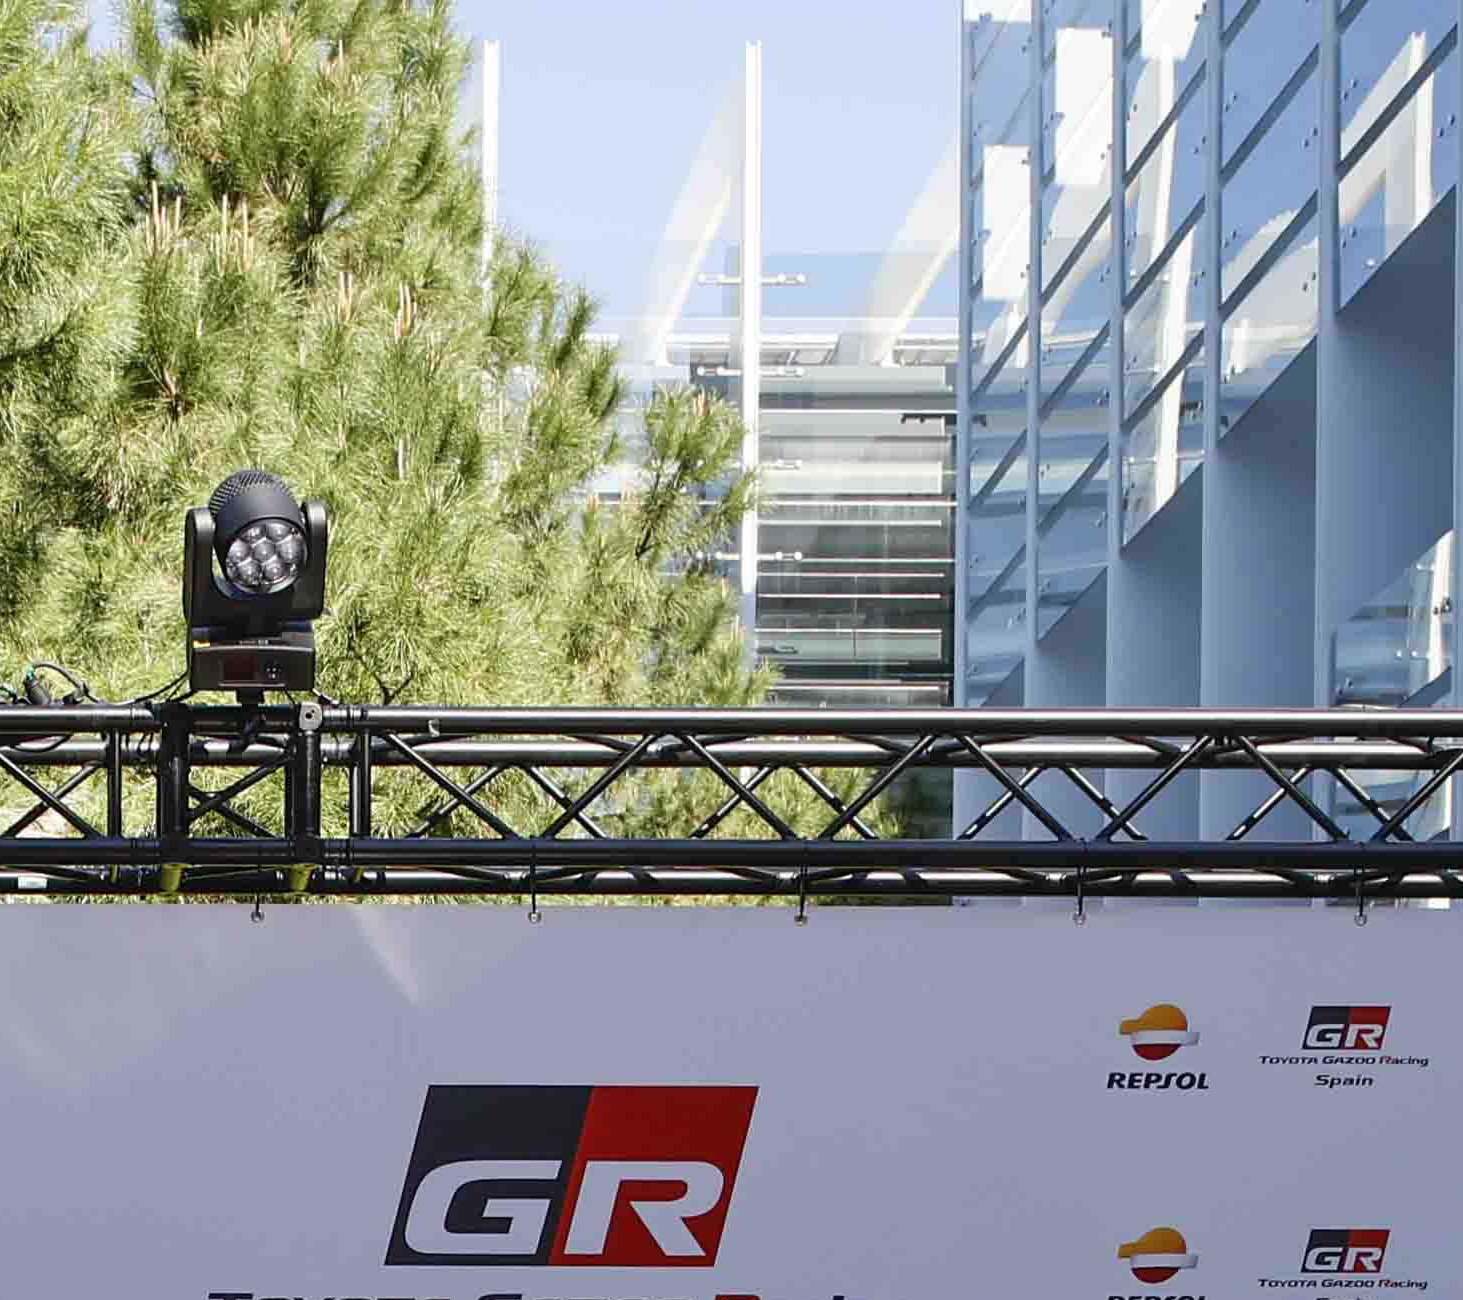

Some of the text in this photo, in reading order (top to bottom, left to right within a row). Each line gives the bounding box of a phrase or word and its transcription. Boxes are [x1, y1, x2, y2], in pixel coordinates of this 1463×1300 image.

[1307, 1024, 1383, 1047] GR
[1260, 1056, 1428, 1067] TOYOTA GAZOO Racing
[1107, 1072, 1209, 1090] REPSOL
[1315, 1075, 1373, 1088] Spain
[404, 1159, 722, 1257] GR
[1306, 1247, 1382, 1271] GR
[1258, 1279, 1428, 1290] TOYOTA GAZOO Racing
